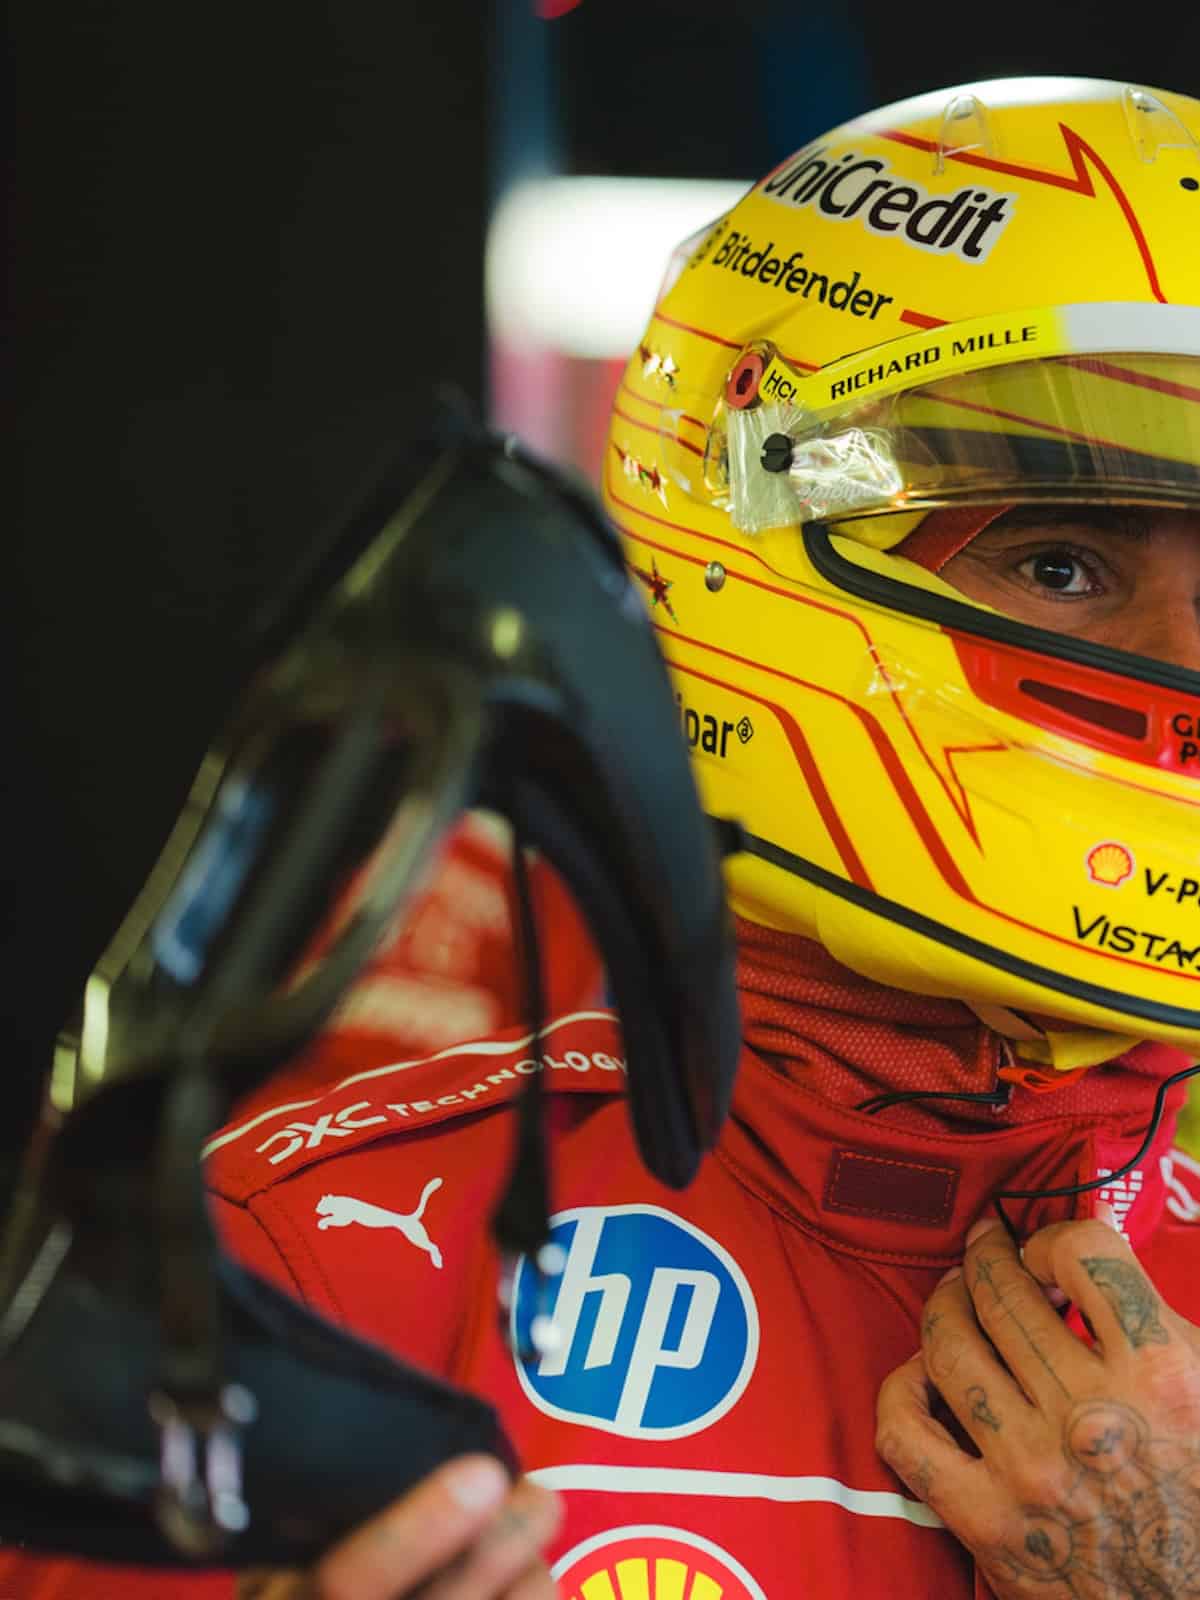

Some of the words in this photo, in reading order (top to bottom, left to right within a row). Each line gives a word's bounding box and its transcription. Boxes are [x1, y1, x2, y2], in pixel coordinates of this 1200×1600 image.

[765, 148, 1008, 258] UniCredit
[712, 231, 893, 321] Bitdefender
[830, 346, 941, 401] RICHARD
[952, 326, 1037, 356] MILLE
[256, 1101, 387, 1165] DXC
[538, 1208, 721, 1430] hp
